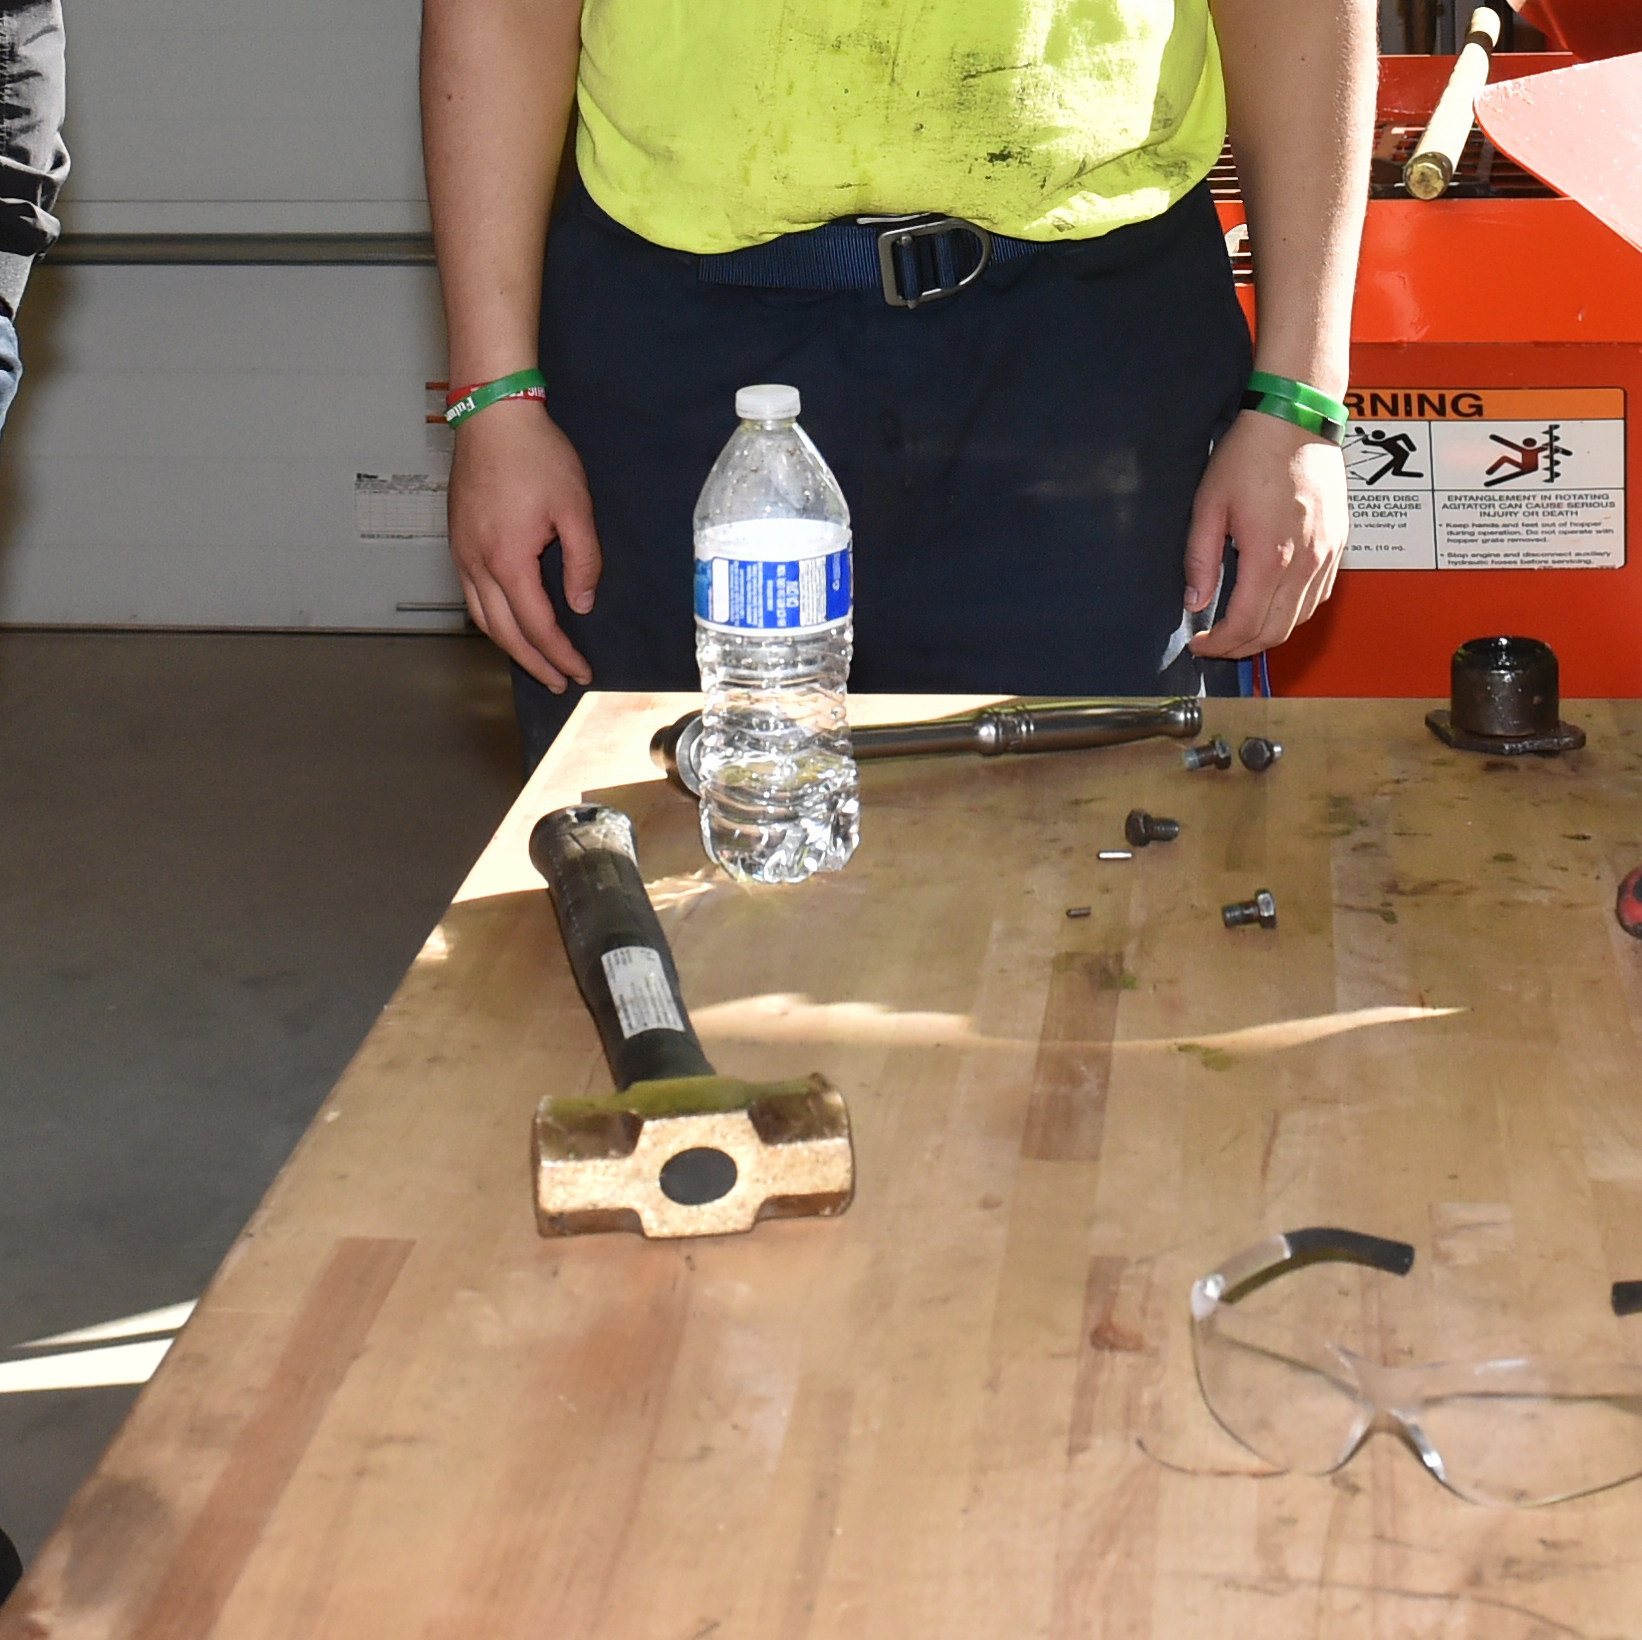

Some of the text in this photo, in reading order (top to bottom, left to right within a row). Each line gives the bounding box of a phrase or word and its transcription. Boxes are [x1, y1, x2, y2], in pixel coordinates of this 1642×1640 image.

[1346, 392, 1485, 418] RNING
[1447, 494, 1537, 502] ENTANGLEMENT
[1555, 493, 1610, 501] ROTATING
[1441, 502, 1496, 510] AGITATOR
[1498, 502, 1523, 510] CAN
[1566, 501, 1616, 509] SERIOUS
[1479, 509, 1579, 518] INJURY OR DEATH
[1375, 544, 1389, 552] (10
